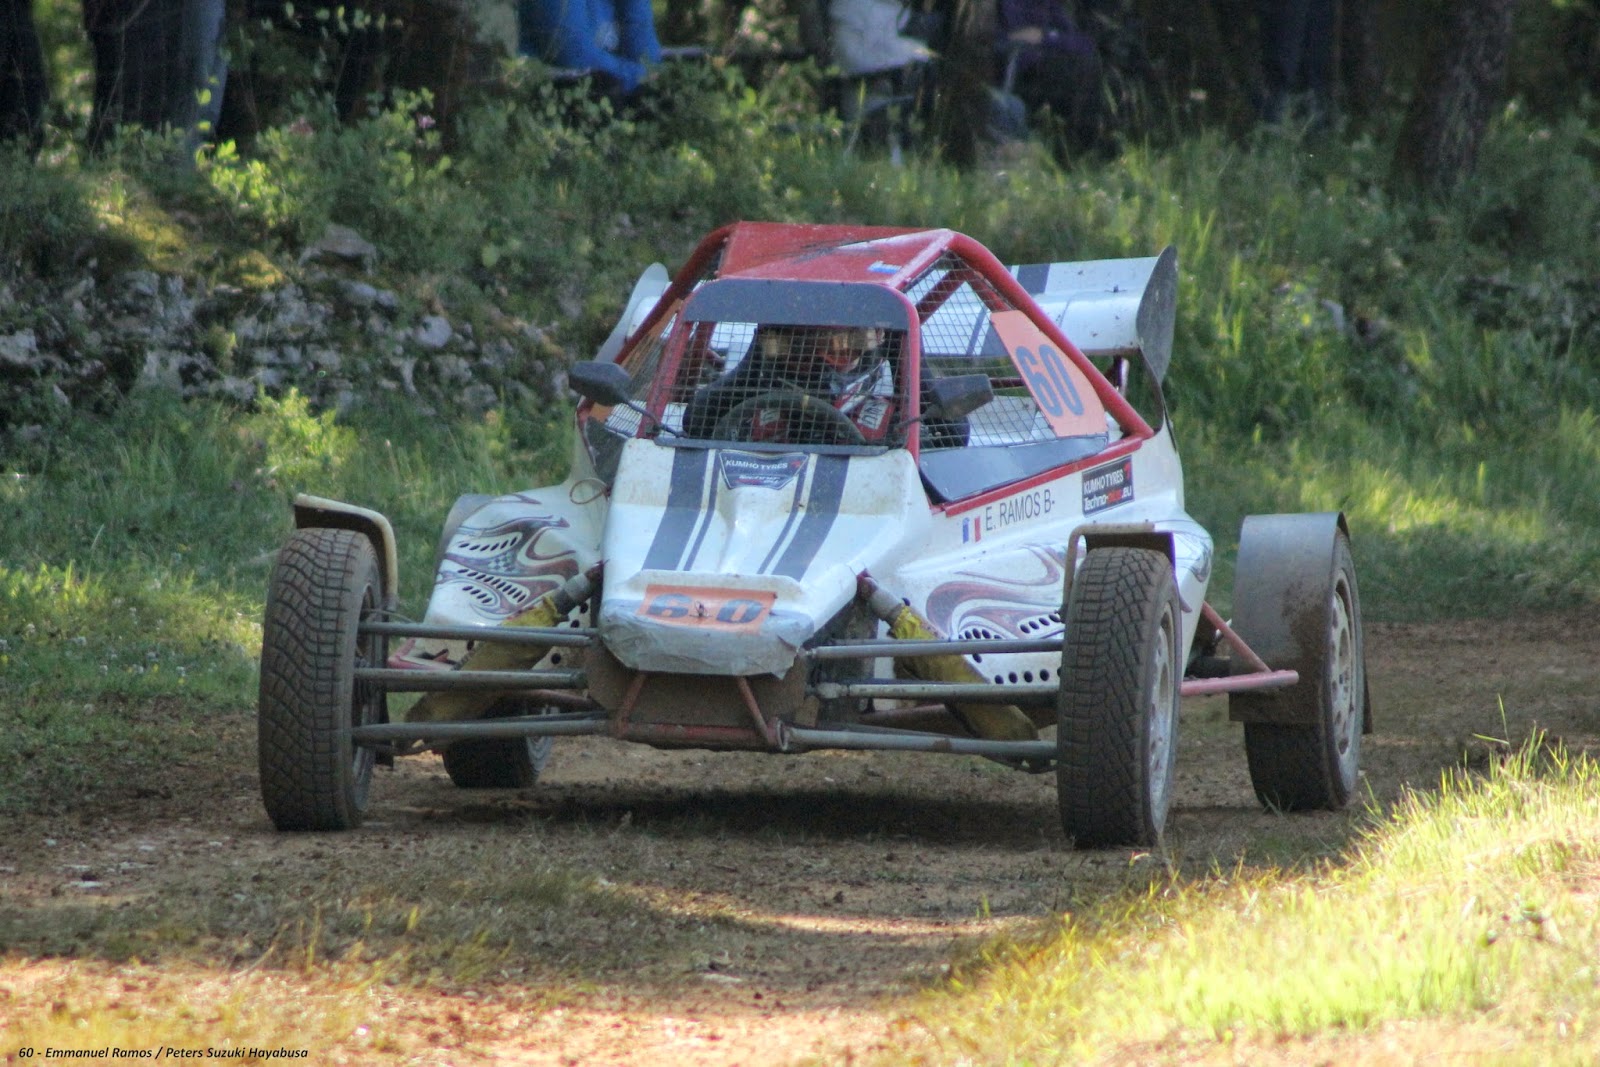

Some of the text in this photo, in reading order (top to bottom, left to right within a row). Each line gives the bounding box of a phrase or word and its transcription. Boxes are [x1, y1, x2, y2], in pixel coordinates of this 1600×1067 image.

[1015, 344, 1084, 417] 60
[725, 459, 788, 470] KUMHO TYRES
[1083, 468, 1124, 495] KUMHO TYRES
[985, 506, 997, 531] E.
[999, 491, 1041, 528] RAMOS
[646, 593, 765, 624] 60
